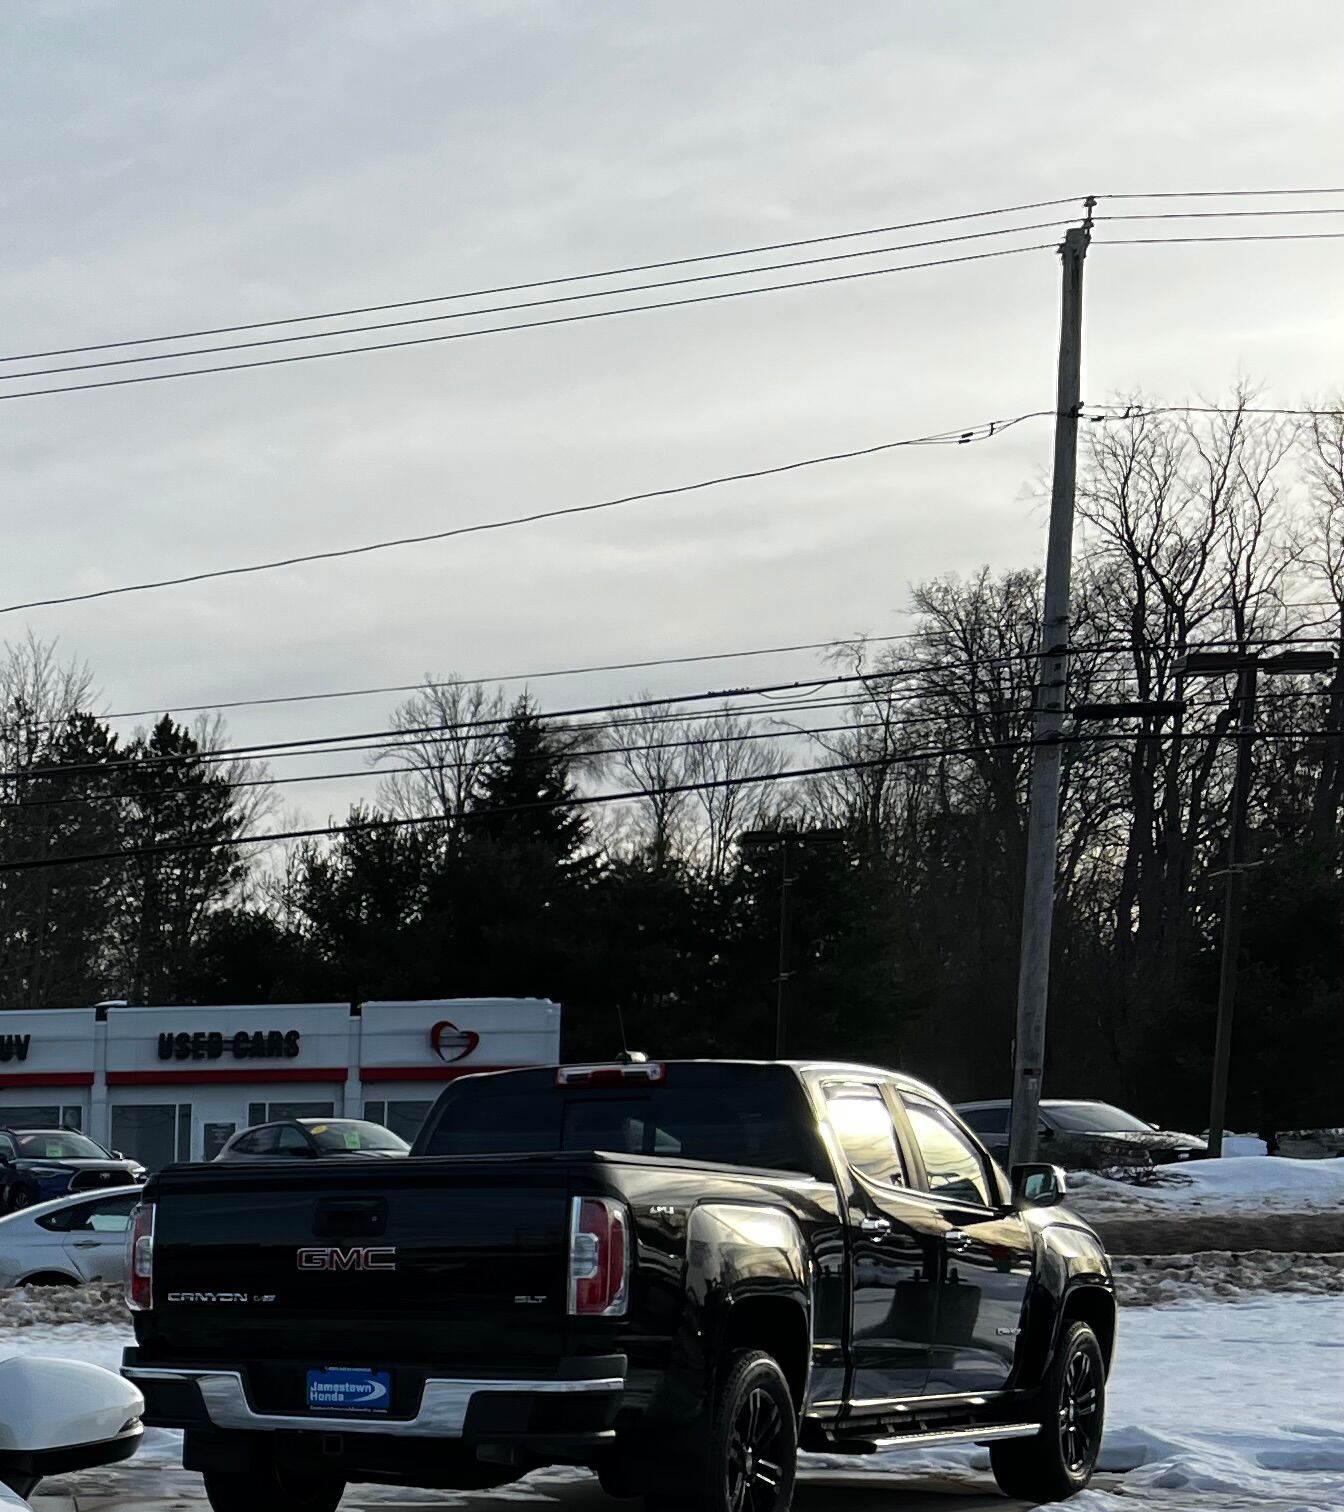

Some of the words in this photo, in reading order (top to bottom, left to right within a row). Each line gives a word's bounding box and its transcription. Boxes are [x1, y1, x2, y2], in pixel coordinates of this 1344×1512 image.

[158, 1032, 223, 1060] USED
[233, 1030, 300, 1058] CARS
[297, 1247, 396, 1271] GMC
[168, 1293, 248, 1302] CANYON
[310, 1381, 372, 1393] Jamestown
[310, 1392, 345, 1401] Honda
